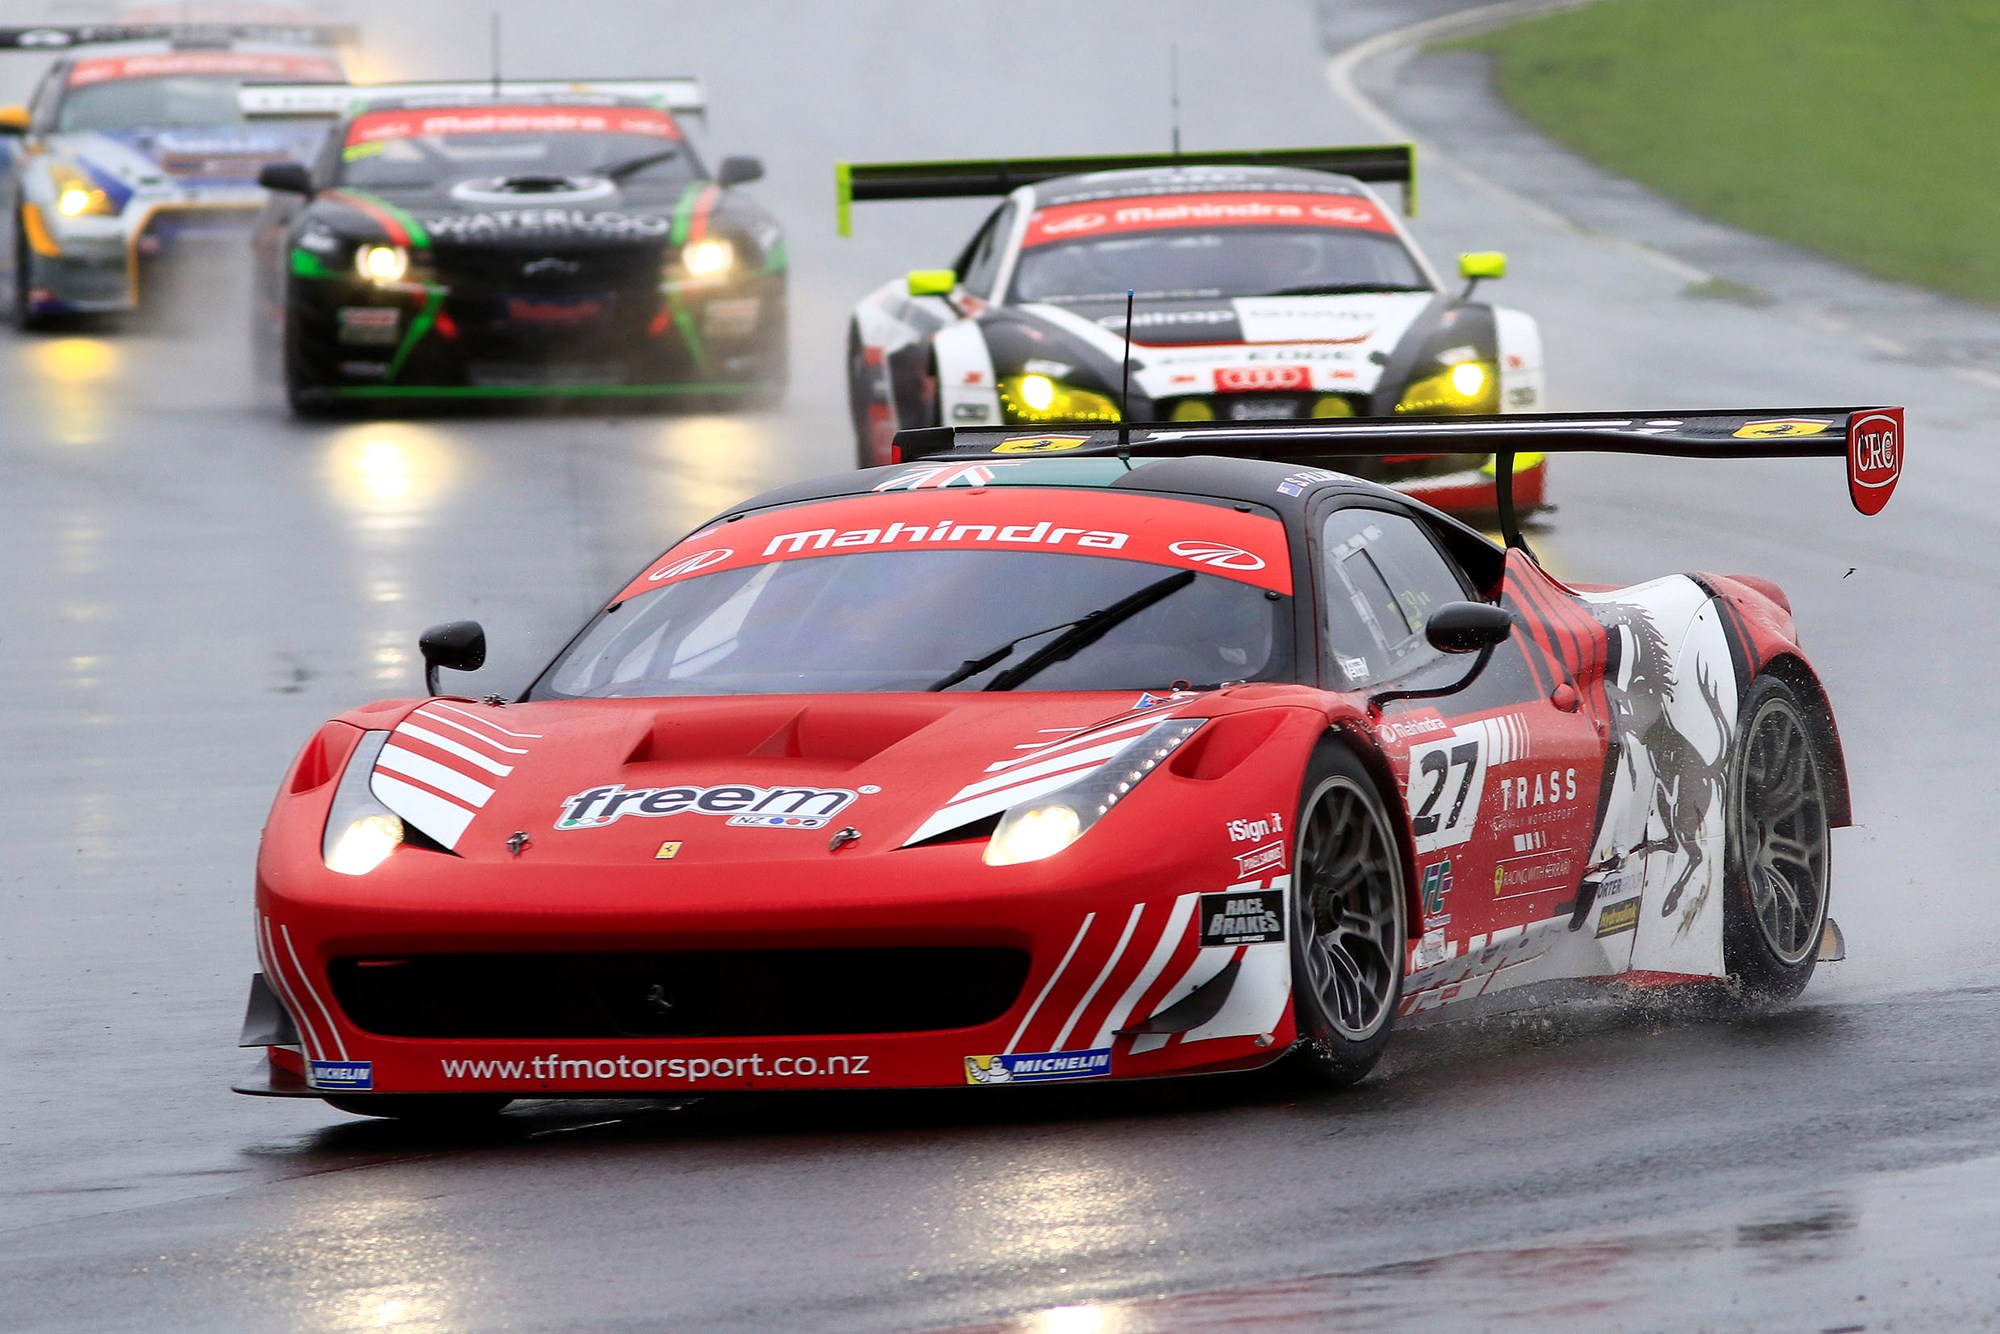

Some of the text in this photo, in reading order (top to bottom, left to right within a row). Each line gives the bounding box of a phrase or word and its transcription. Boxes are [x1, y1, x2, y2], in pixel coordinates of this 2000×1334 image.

[428, 209, 671, 237] WATERLOO
[761, 519, 1131, 557] mahindra
[1413, 741, 1480, 837] 27
[1500, 767, 1577, 811] TRASS
[566, 787, 848, 820] freem
[736, 816, 765, 826] NZ
[1226, 818, 1270, 842] iSign
[1226, 898, 1264, 915] RACE
[1208, 911, 1281, 935] BRAKES
[315, 1067, 369, 1081] MICHELIN
[440, 1053, 871, 1082] www.tfmotorsport.co.nz
[1012, 1053, 1110, 1073] MICHELIN
